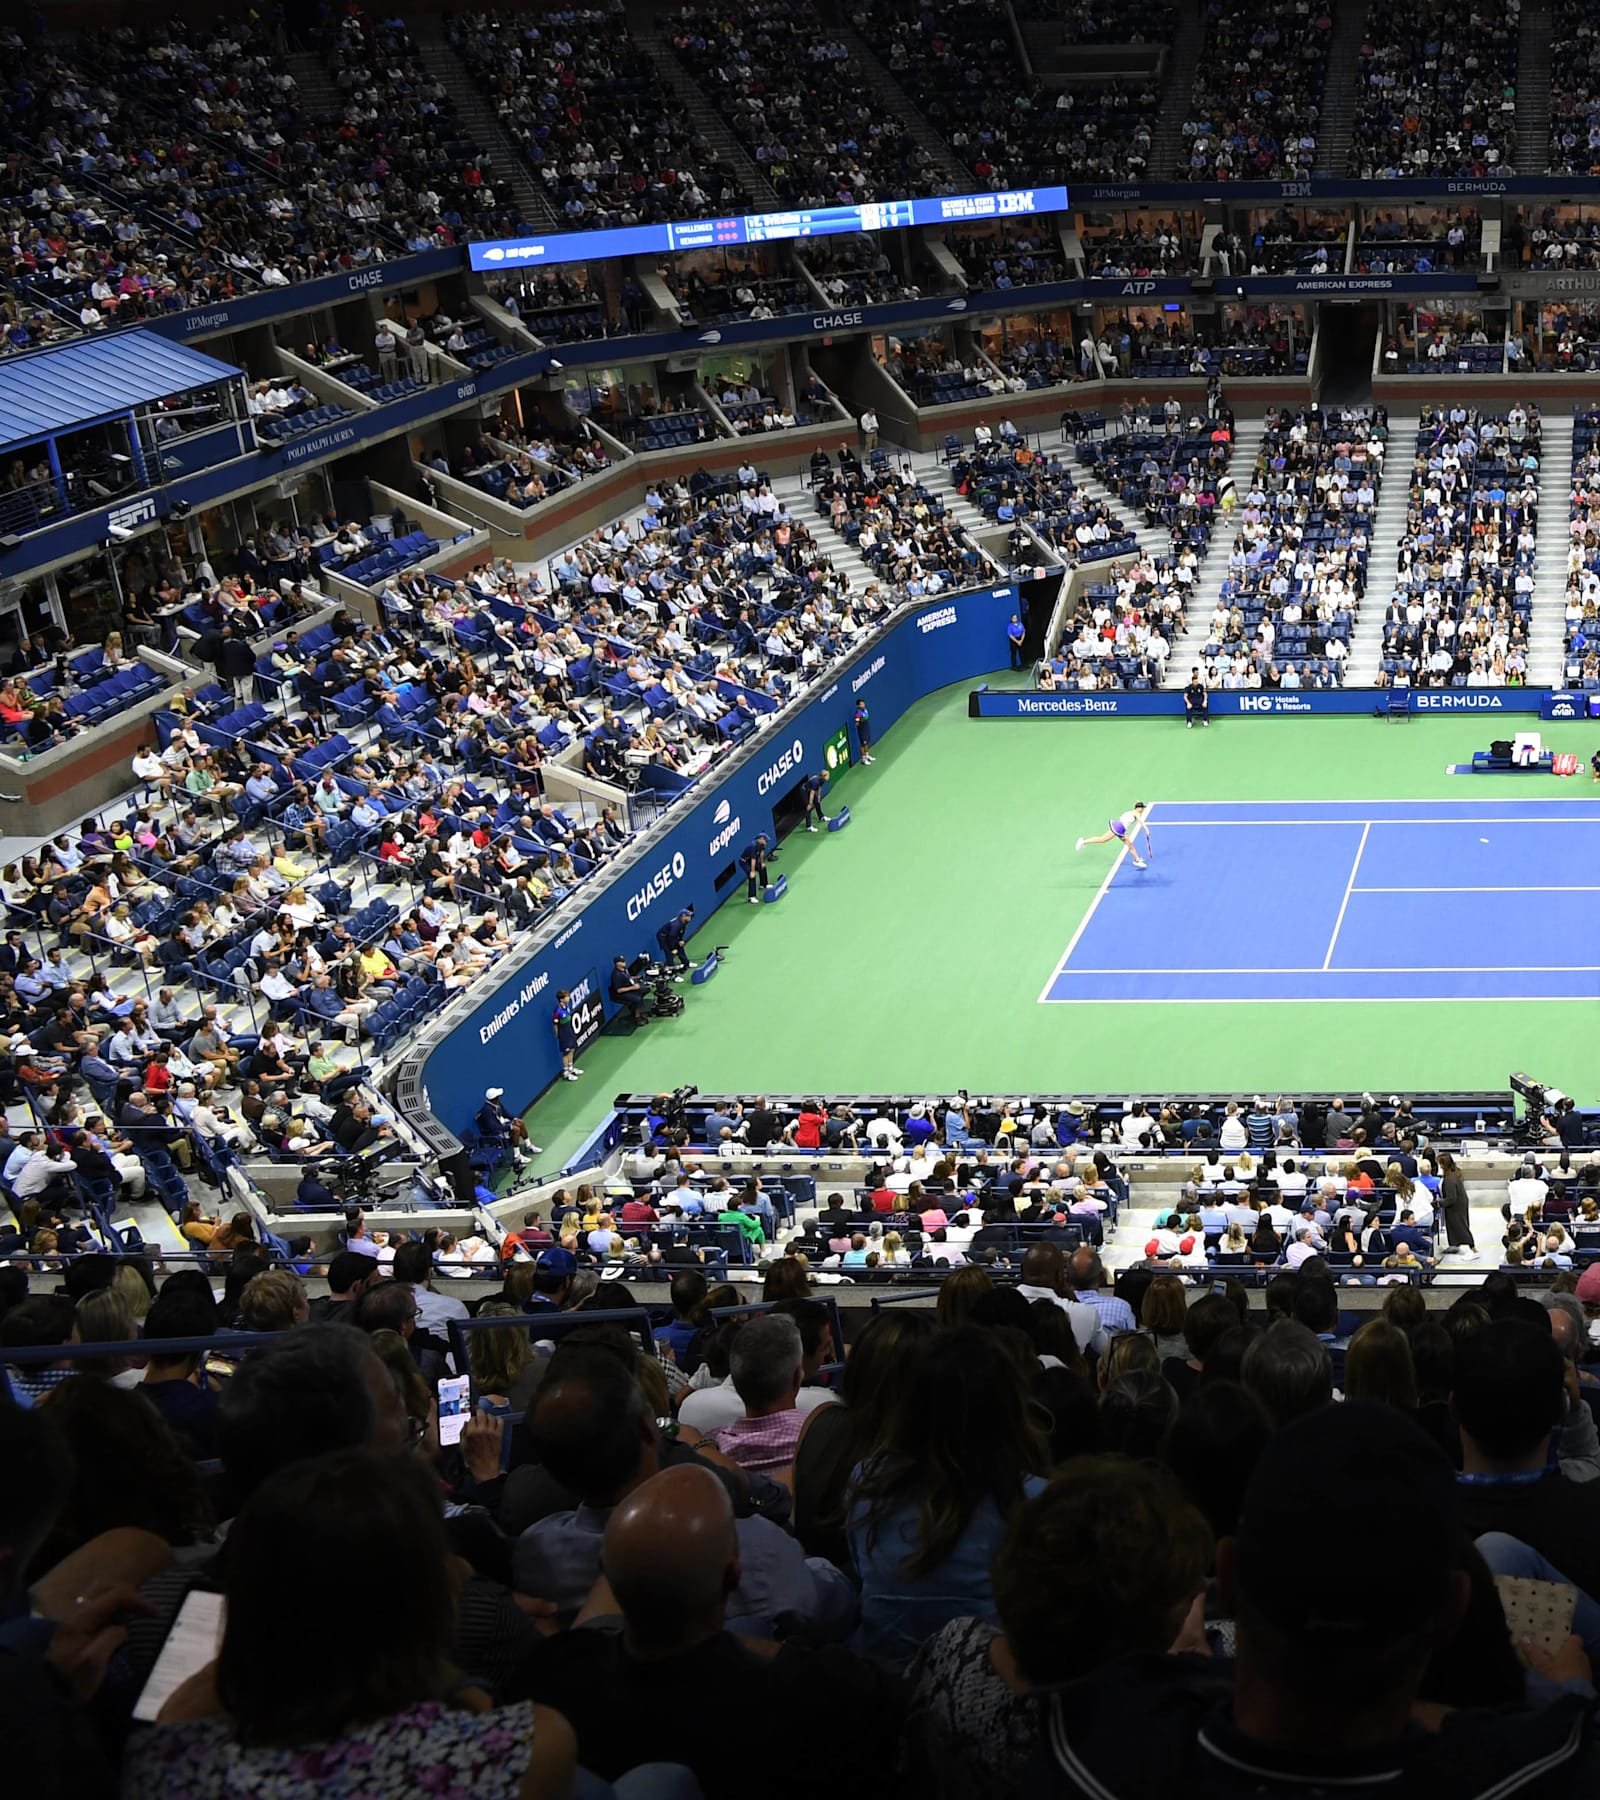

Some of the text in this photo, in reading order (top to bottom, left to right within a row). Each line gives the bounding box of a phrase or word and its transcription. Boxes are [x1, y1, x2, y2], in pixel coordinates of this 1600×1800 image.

[1092, 188, 1141, 200] J.P.Morgan
[1281, 182, 1312, 196] IBM
[1447, 182, 1507, 191] BERMUDA
[997, 192, 1035, 213] IBM
[348, 269, 384, 291] CHASE
[1121, 281, 1156, 295] ATP
[1296, 280, 1393, 291] AMERICAN EXPRESS
[186, 312, 230, 332] J.P.Morgan
[813, 311, 863, 329] CHASE
[457, 382, 476, 399] evian
[287, 427, 355, 461] POLO RALPH LAUREN
[108, 498, 156, 530] ESPN
[916, 606, 956, 627] AMERICAN
[922, 614, 957, 634] EXPRESS
[1017, 698, 1118, 712] Mercedes-Benz
[1239, 696, 1272, 710] IHG
[1275, 696, 1300, 704] Hotels
[1275, 703, 1311, 711] & Resorts
[1416, 695, 1503, 707] BERMUDA
[1551, 708, 1575, 717] evian
[757, 749, 794, 796] CHASE
[709, 815, 741, 856] us open
[626, 863, 674, 922] CHASE
[569, 977, 591, 1010] IBM
[479, 971, 550, 1045] Emirates Airline
